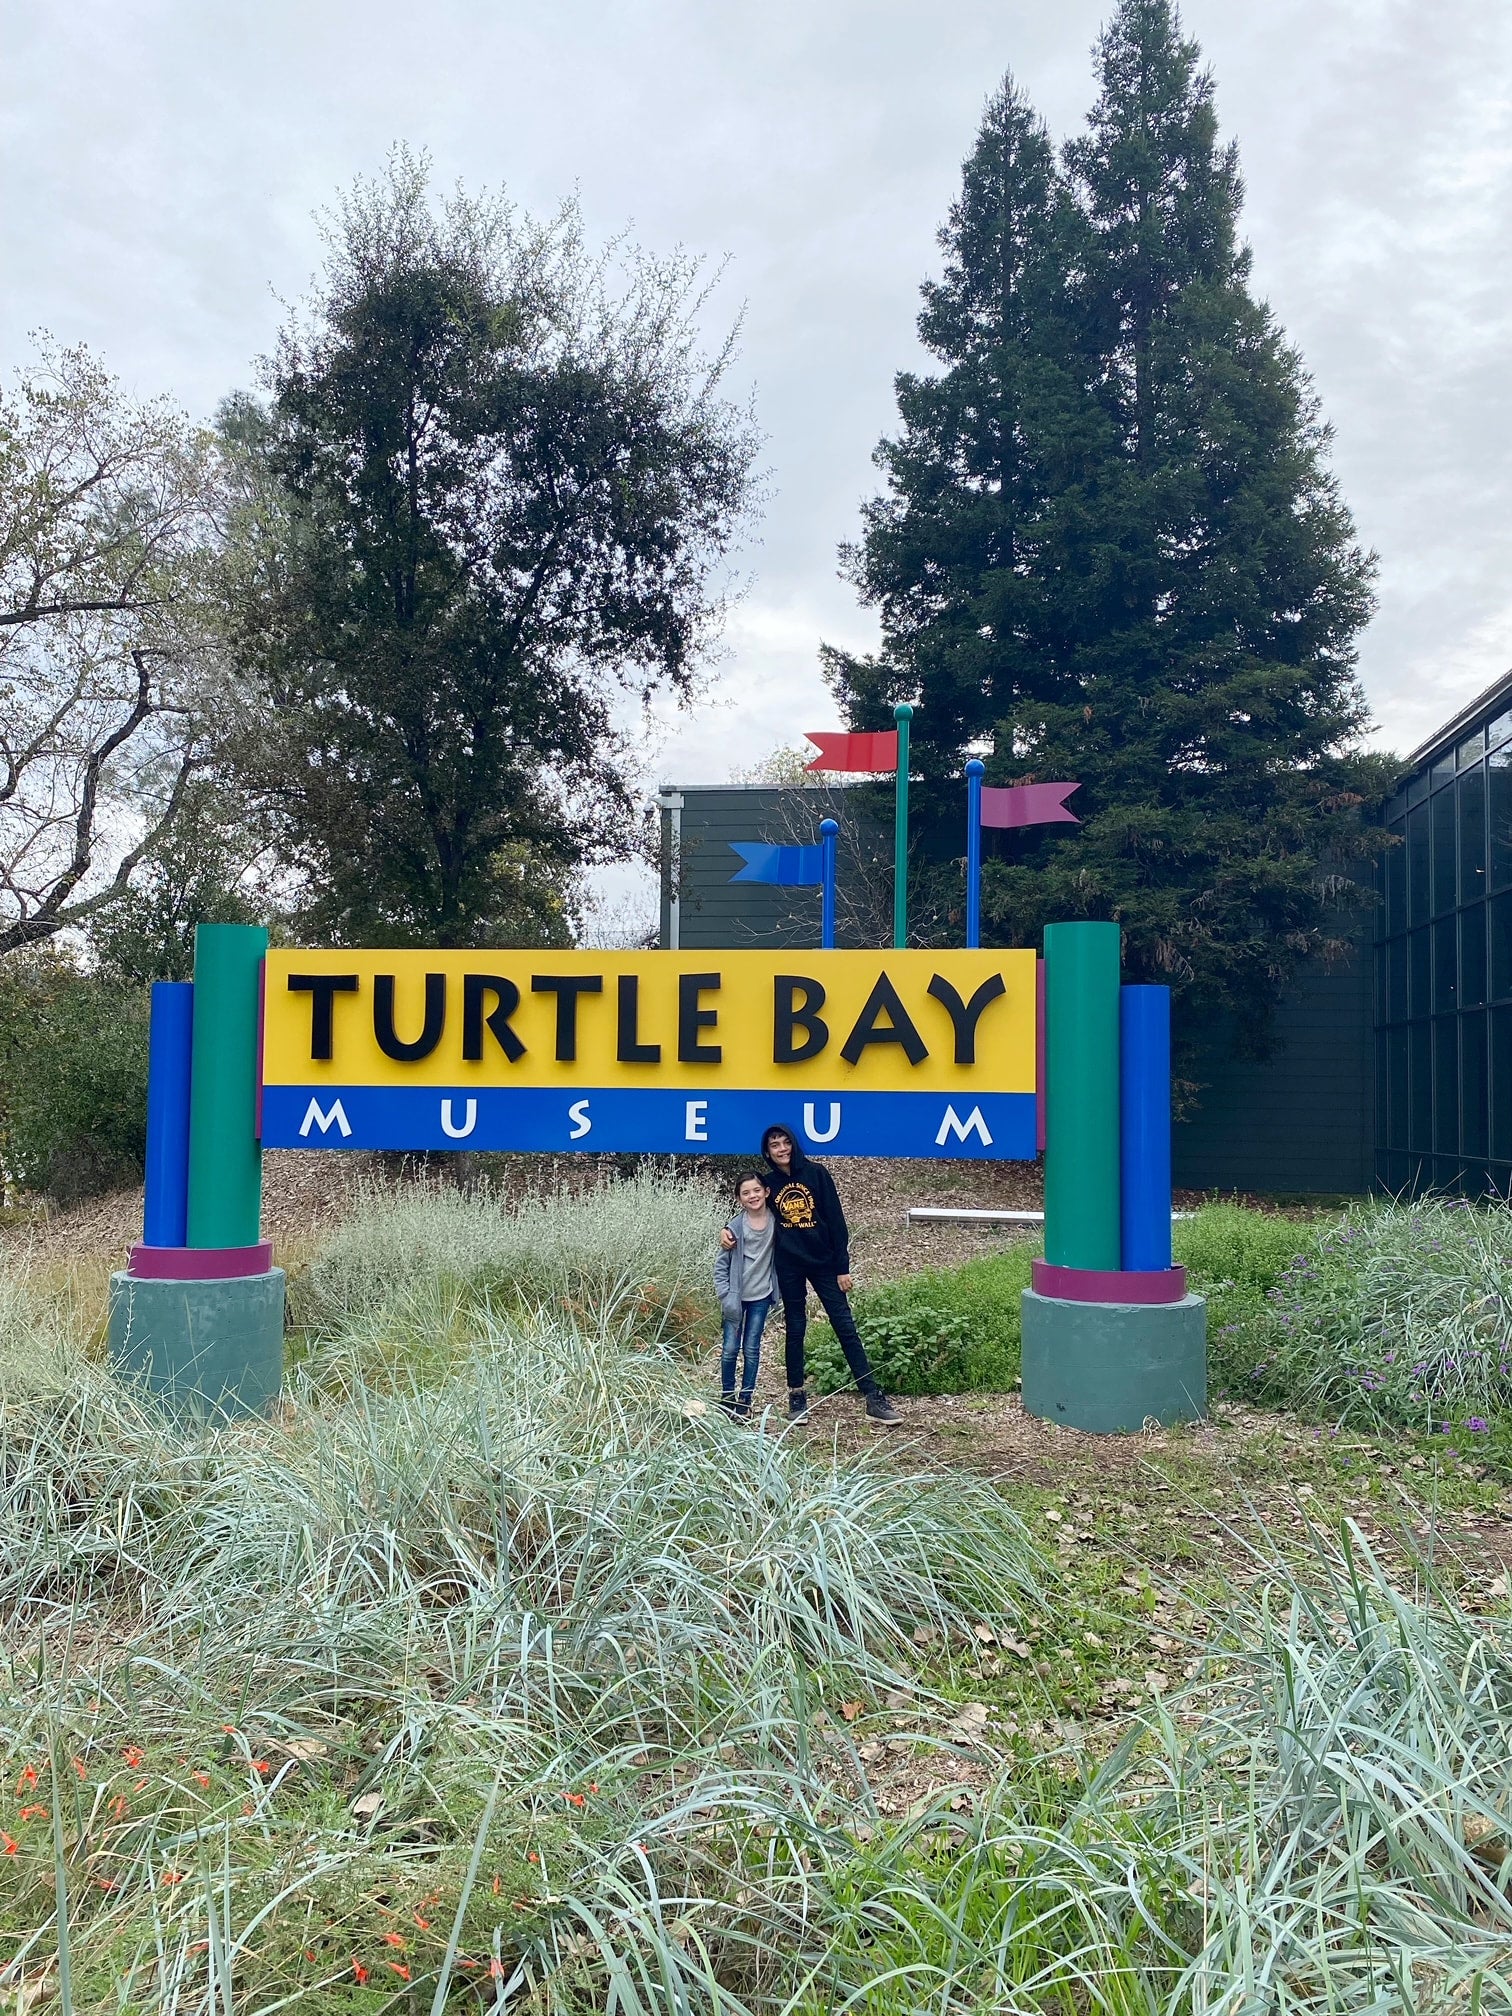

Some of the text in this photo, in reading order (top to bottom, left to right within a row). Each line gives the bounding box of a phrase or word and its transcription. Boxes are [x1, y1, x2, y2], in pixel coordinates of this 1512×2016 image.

[287, 971, 1006, 1066] TURTLE BAY
[299, 1097, 993, 1147] MUSEUM
[783, 1200, 805, 1210] VANS
